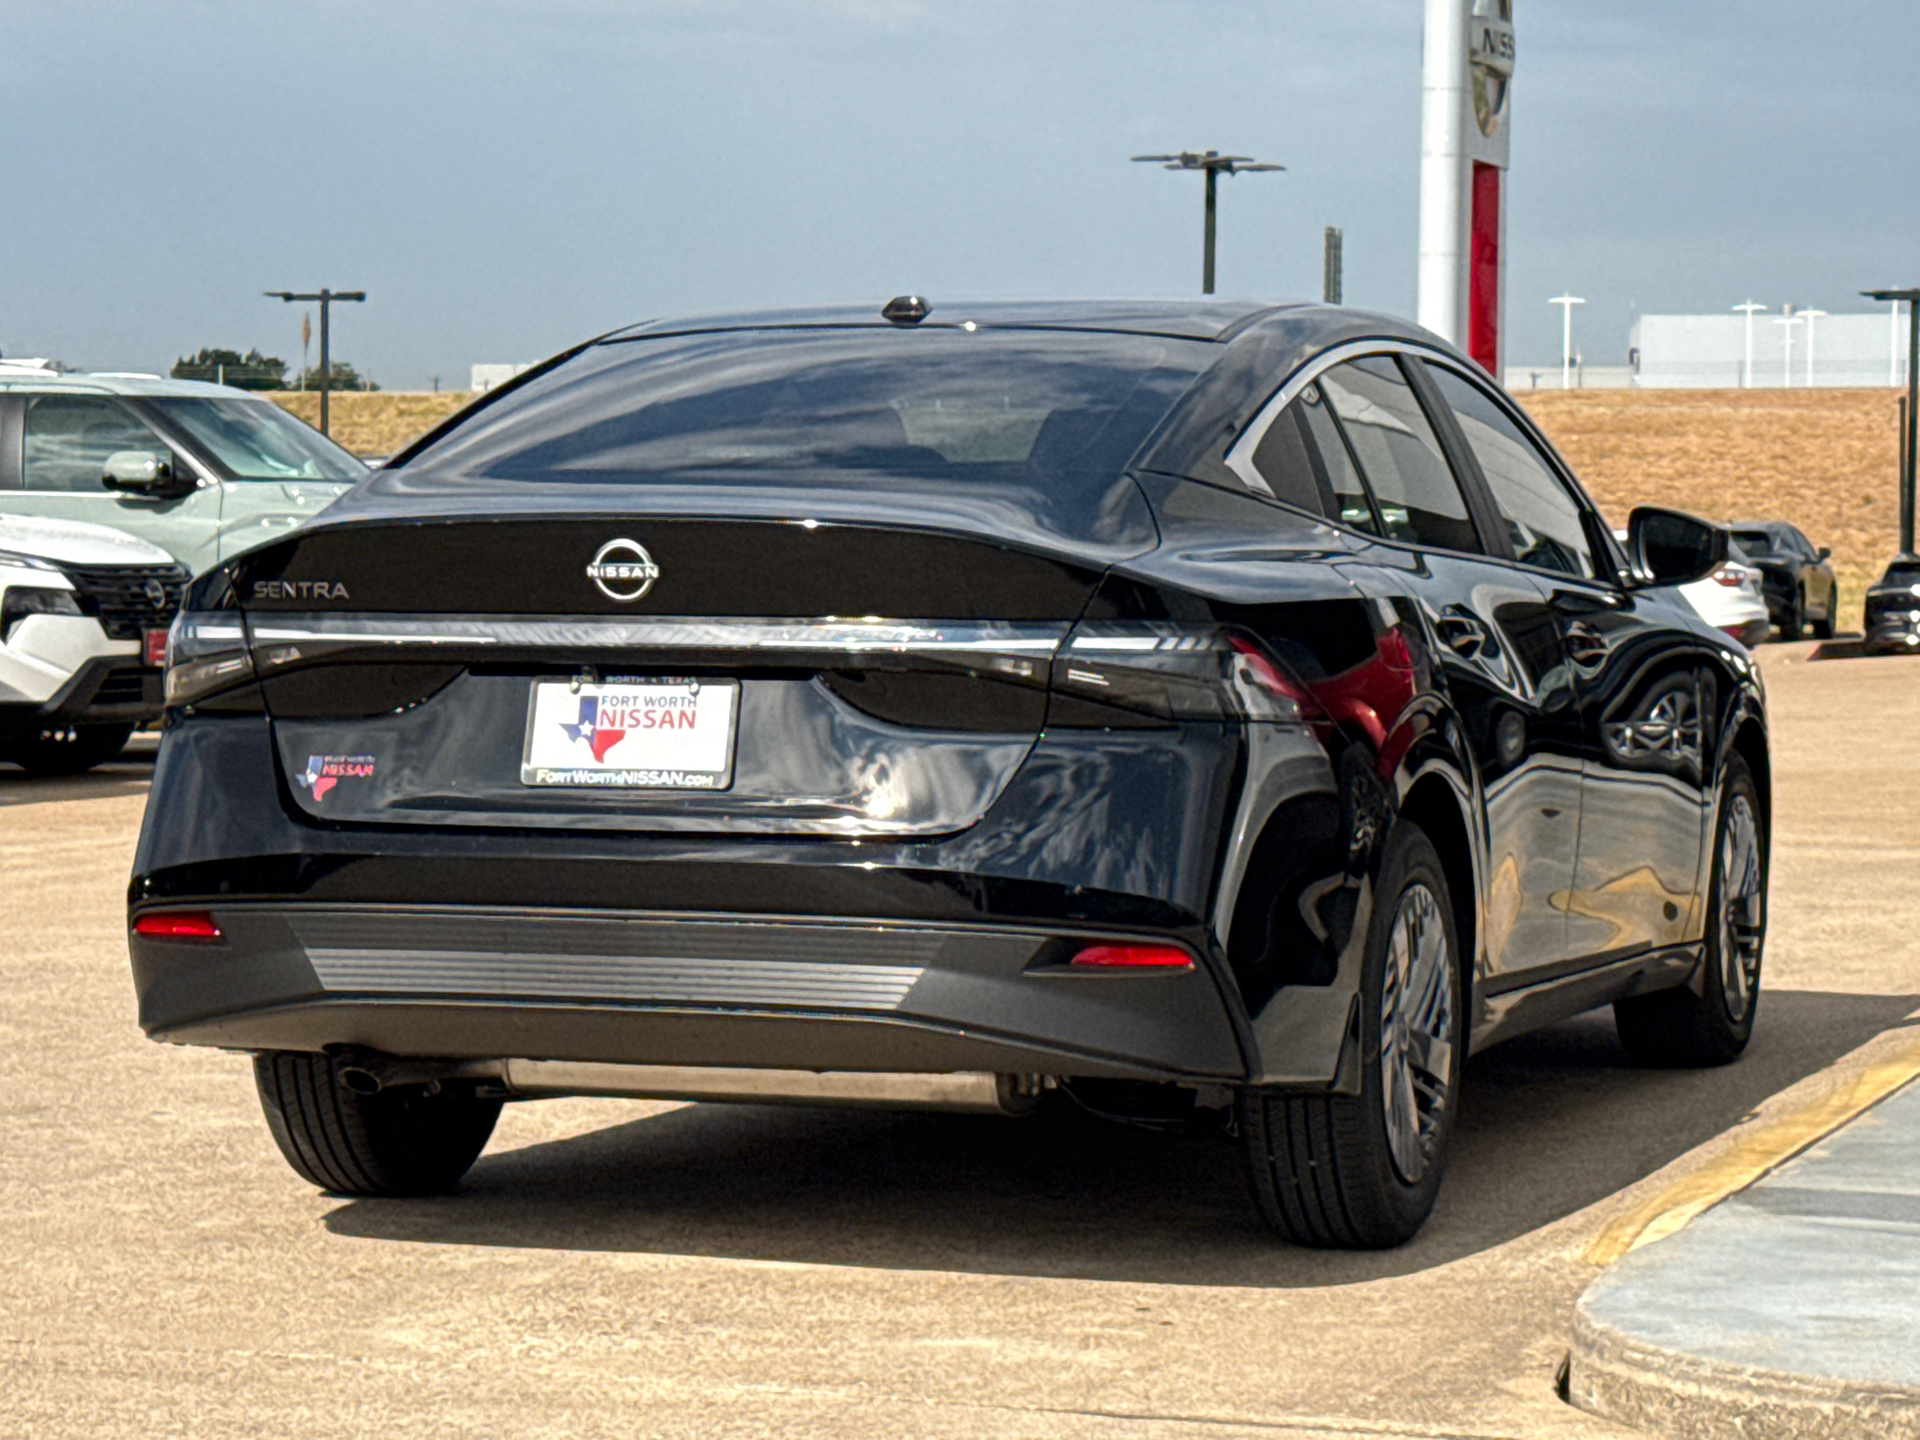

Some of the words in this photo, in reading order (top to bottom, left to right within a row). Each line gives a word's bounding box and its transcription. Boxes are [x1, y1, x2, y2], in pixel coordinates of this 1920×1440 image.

[586, 565, 660, 579] NISSAN
[253, 580, 350, 600] SENTRA
[601, 695, 640, 708] FORT
[643, 695, 698, 709] WORTH
[599, 708, 697, 730] NISSAN
